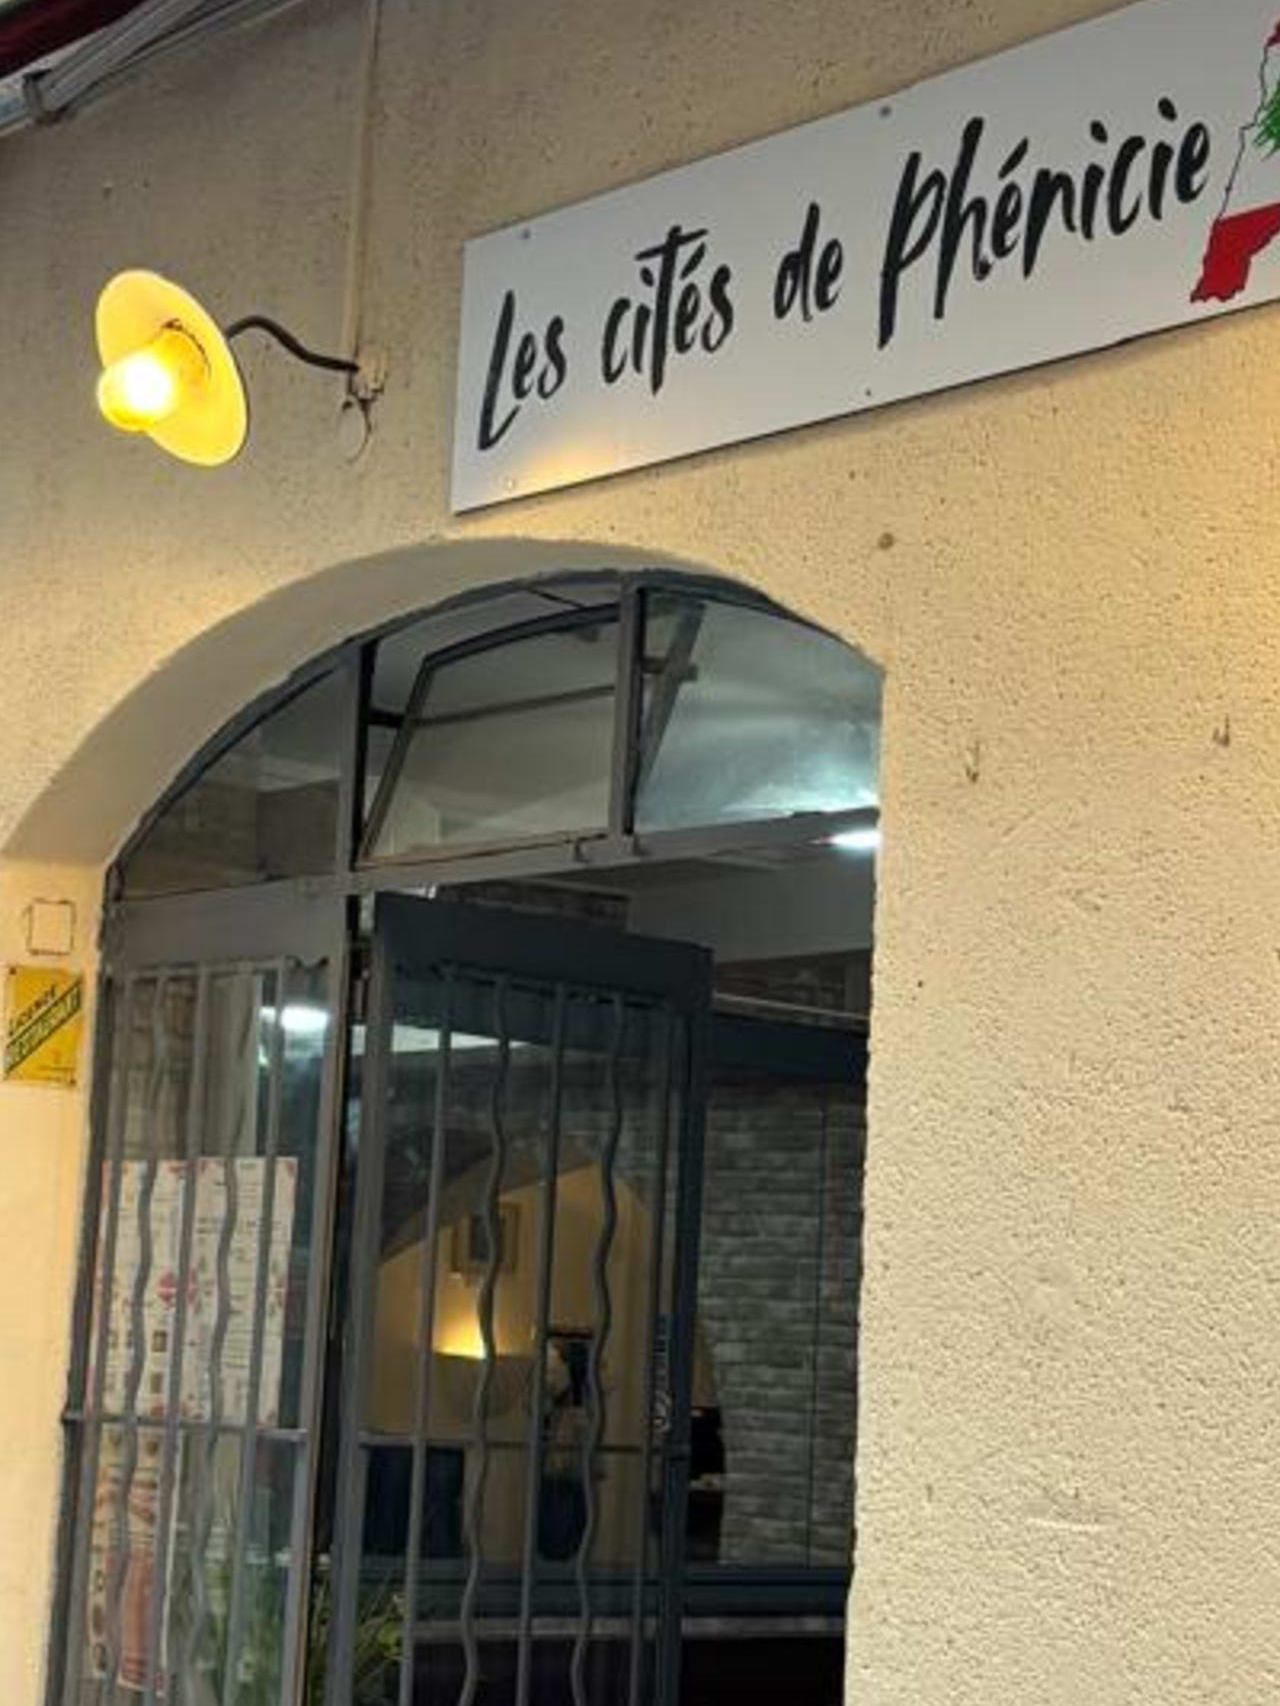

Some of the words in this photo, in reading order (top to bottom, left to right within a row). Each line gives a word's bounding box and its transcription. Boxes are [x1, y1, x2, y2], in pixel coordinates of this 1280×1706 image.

[477, 290, 568, 451] Les
[600, 224, 735, 396] cités
[773, 202, 844, 324] de
[877, 97, 1211, 351] Phénicie
